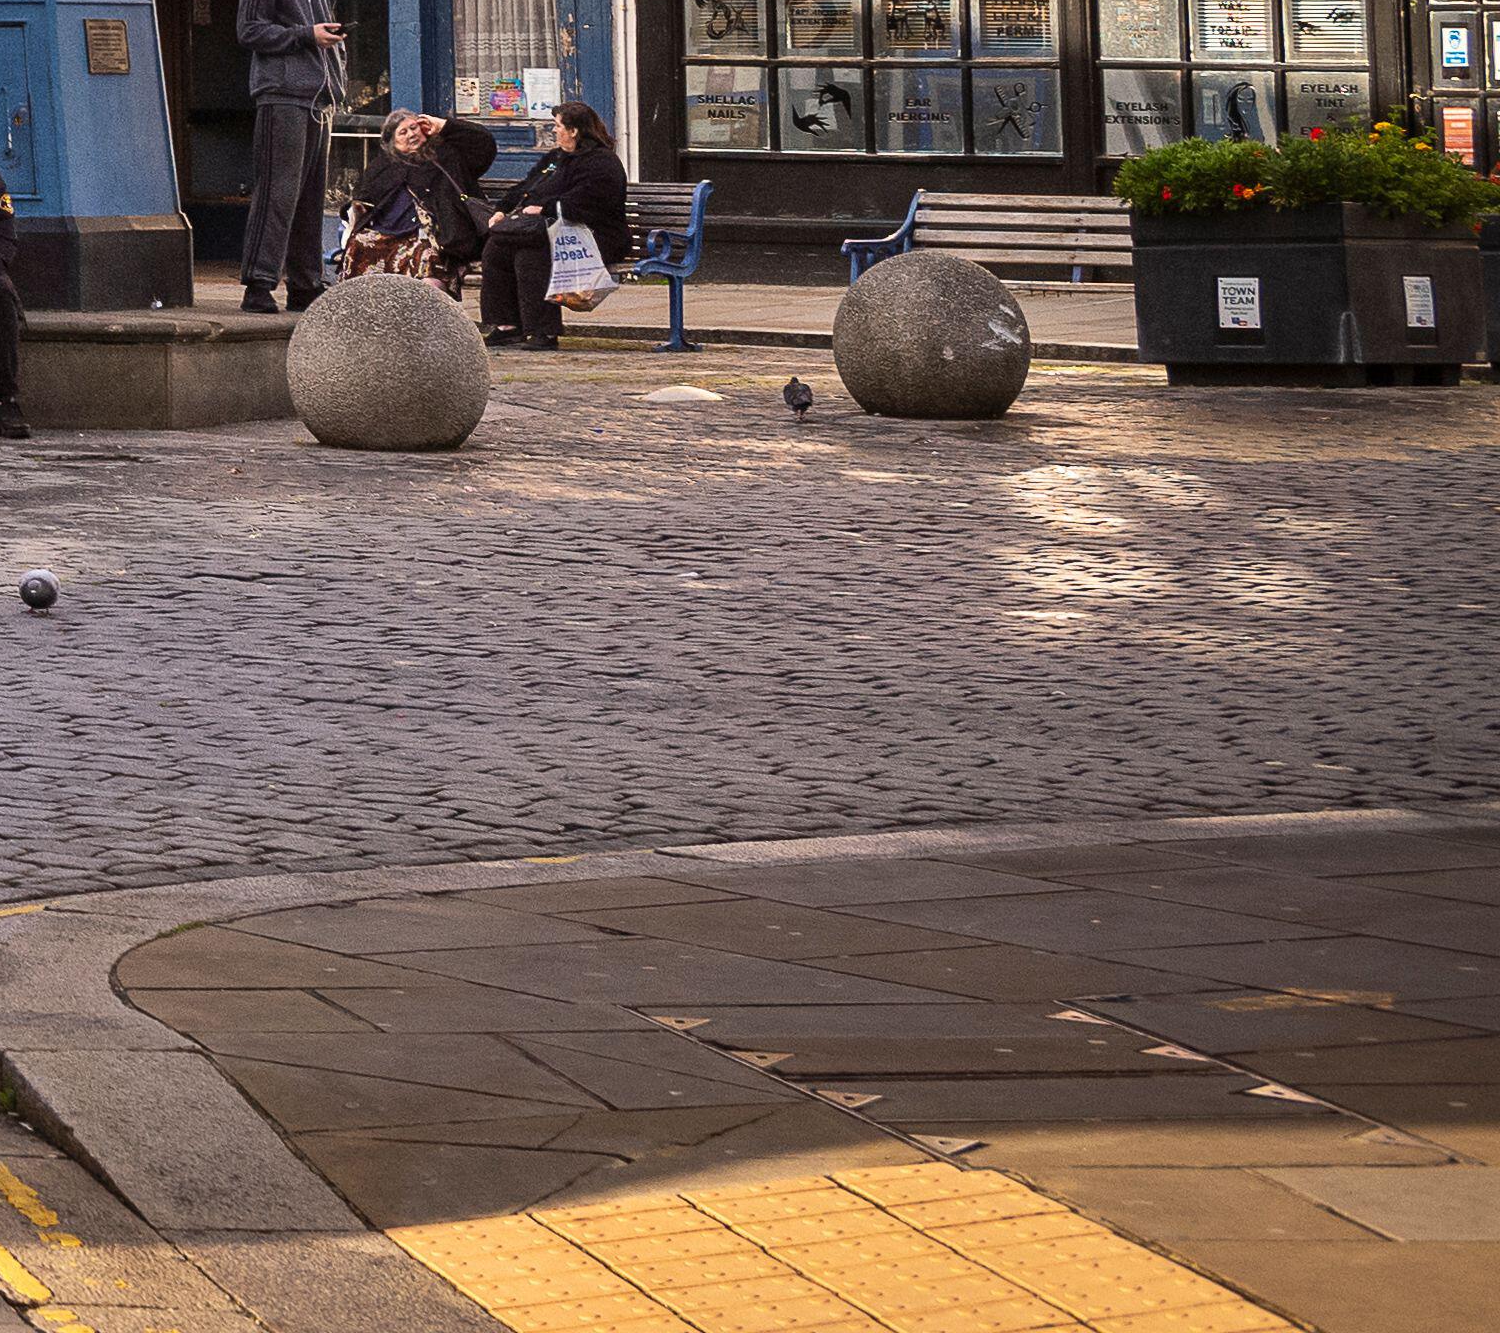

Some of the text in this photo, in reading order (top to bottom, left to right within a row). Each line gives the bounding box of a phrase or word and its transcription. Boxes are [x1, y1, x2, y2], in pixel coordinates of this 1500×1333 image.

[1300, 83, 1359, 94] EYELASH
[698, 94, 756, 106] SHELLAC
[905, 98, 932, 108] EAR
[1315, 98, 1345, 109] TINT
[1115, 101, 1169, 112] EYELASH
[707, 109, 747, 120] NAILS
[888, 112, 950, 122] PIERCING
[1104, 114, 1181, 126] EXTENSION'S
[1221, 286, 1256, 296] TOWN
[1222, 296, 1255, 305] TEAM
